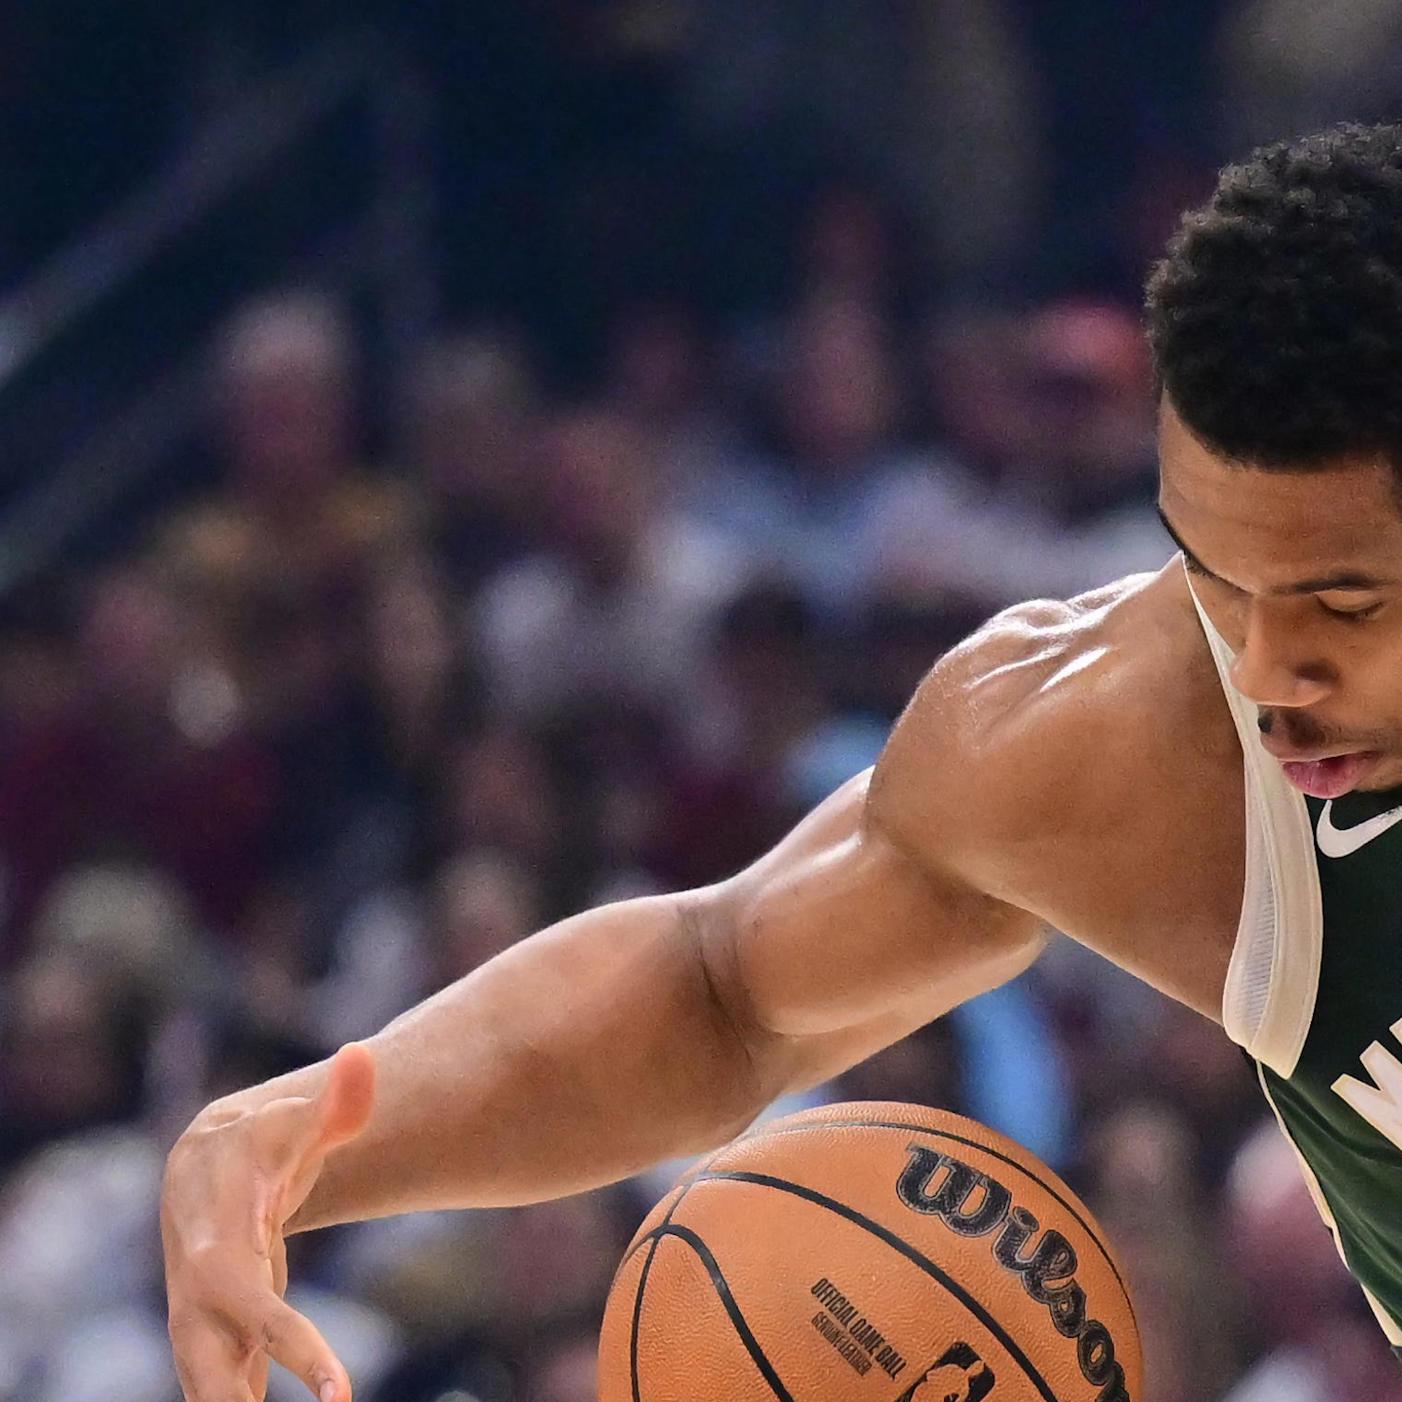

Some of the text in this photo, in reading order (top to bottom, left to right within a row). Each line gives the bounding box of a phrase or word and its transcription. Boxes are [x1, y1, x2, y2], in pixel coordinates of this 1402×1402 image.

[811, 1278, 907, 1380] OFFICIAL GAME BALL
